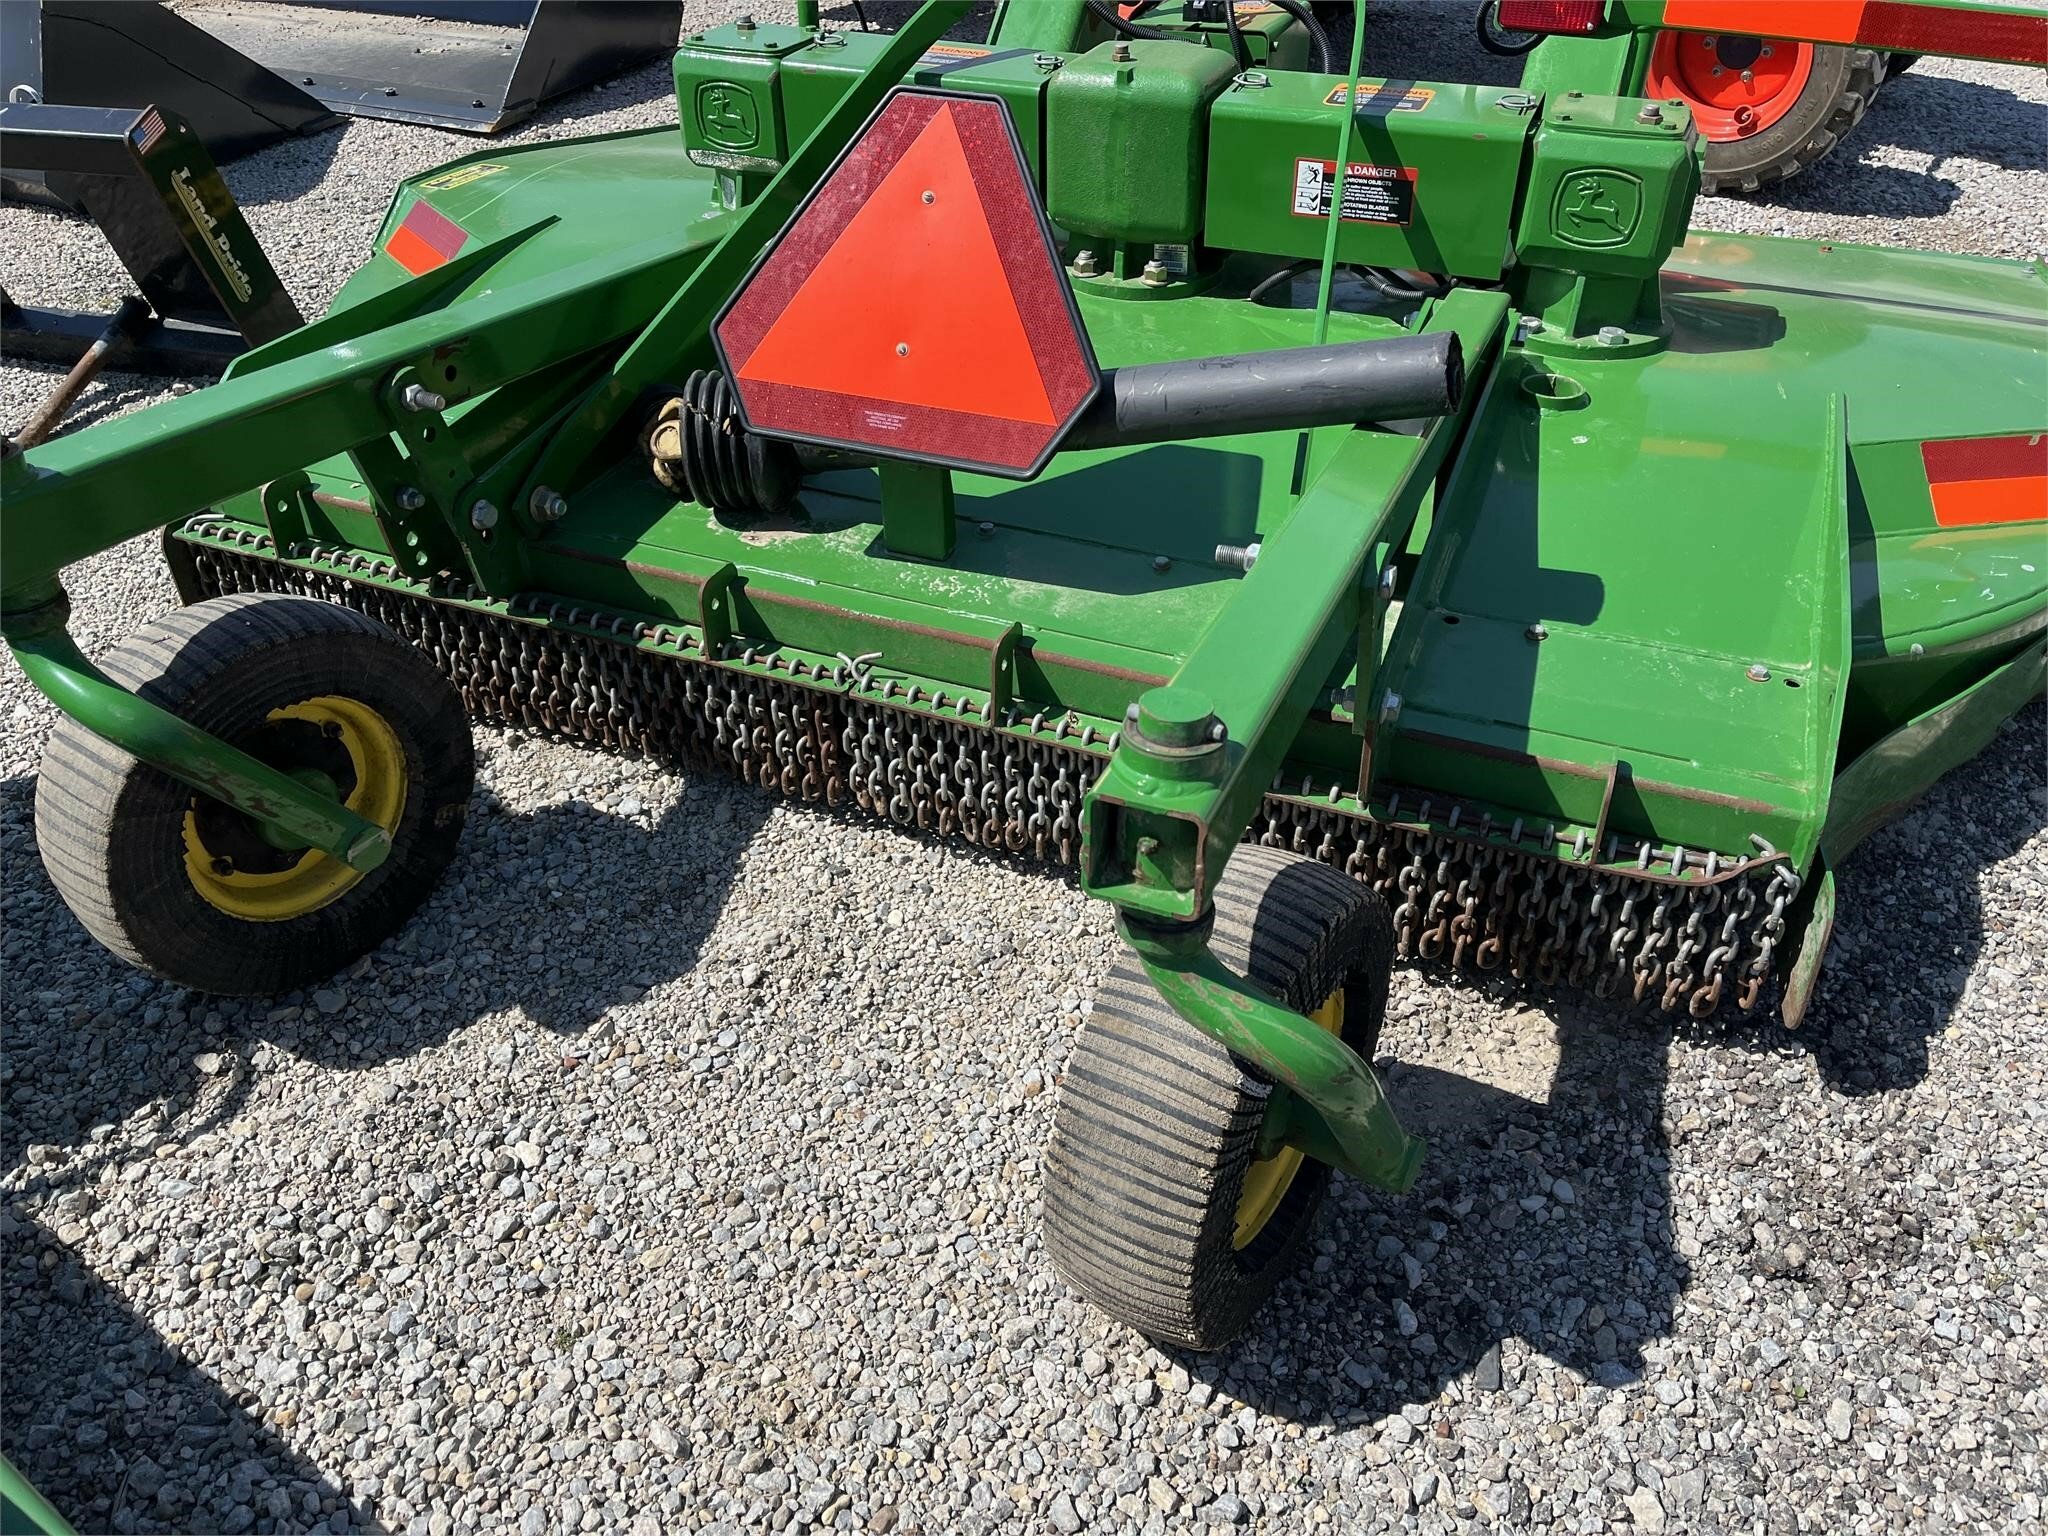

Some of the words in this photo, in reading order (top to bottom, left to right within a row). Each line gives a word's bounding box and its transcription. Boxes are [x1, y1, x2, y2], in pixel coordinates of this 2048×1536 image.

[1358, 86, 1430, 96] WARNING
[1353, 165, 1397, 178] DANGER
[178, 166, 218, 229] Land
[216, 232, 253, 298] Pride
